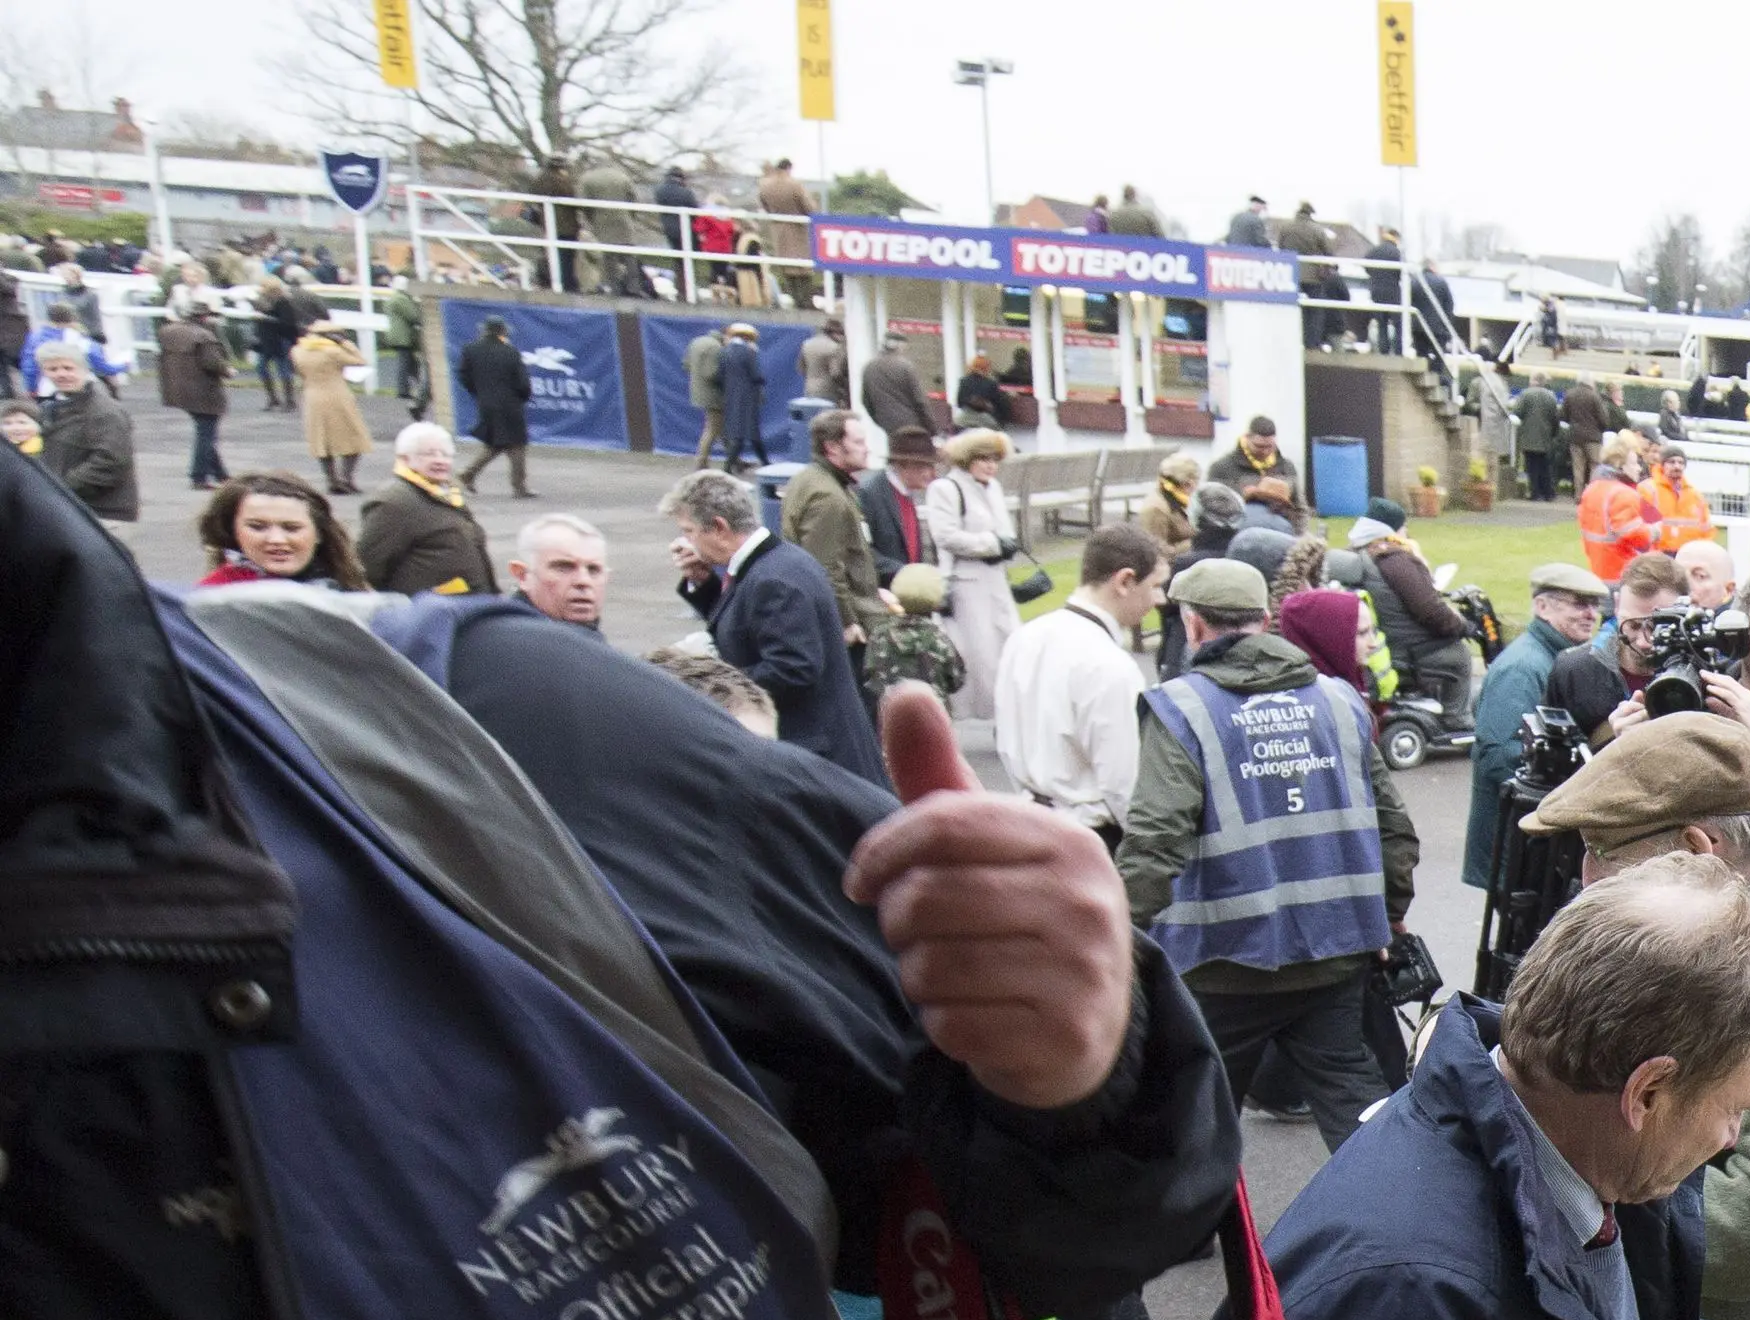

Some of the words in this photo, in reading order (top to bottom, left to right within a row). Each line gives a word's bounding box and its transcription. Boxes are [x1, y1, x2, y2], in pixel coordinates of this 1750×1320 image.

[1385, 51, 1411, 152] betfair
[818, 228, 1000, 270] TOTEPOOL
[1016, 242, 1198, 284] TOTEPOOL
[1208, 254, 1298, 293] TOTEPOOL
[529, 376, 597, 400] BURY
[1230, 704, 1316, 727] NEWBURY
[1245, 719, 1310, 735] RACECOURSE
[1252, 736, 1311, 759] Official
[1286, 787, 1305, 812] 5
[457, 1134, 696, 1297] NEWBURY
[511, 1182, 699, 1306] RACECOURSE
